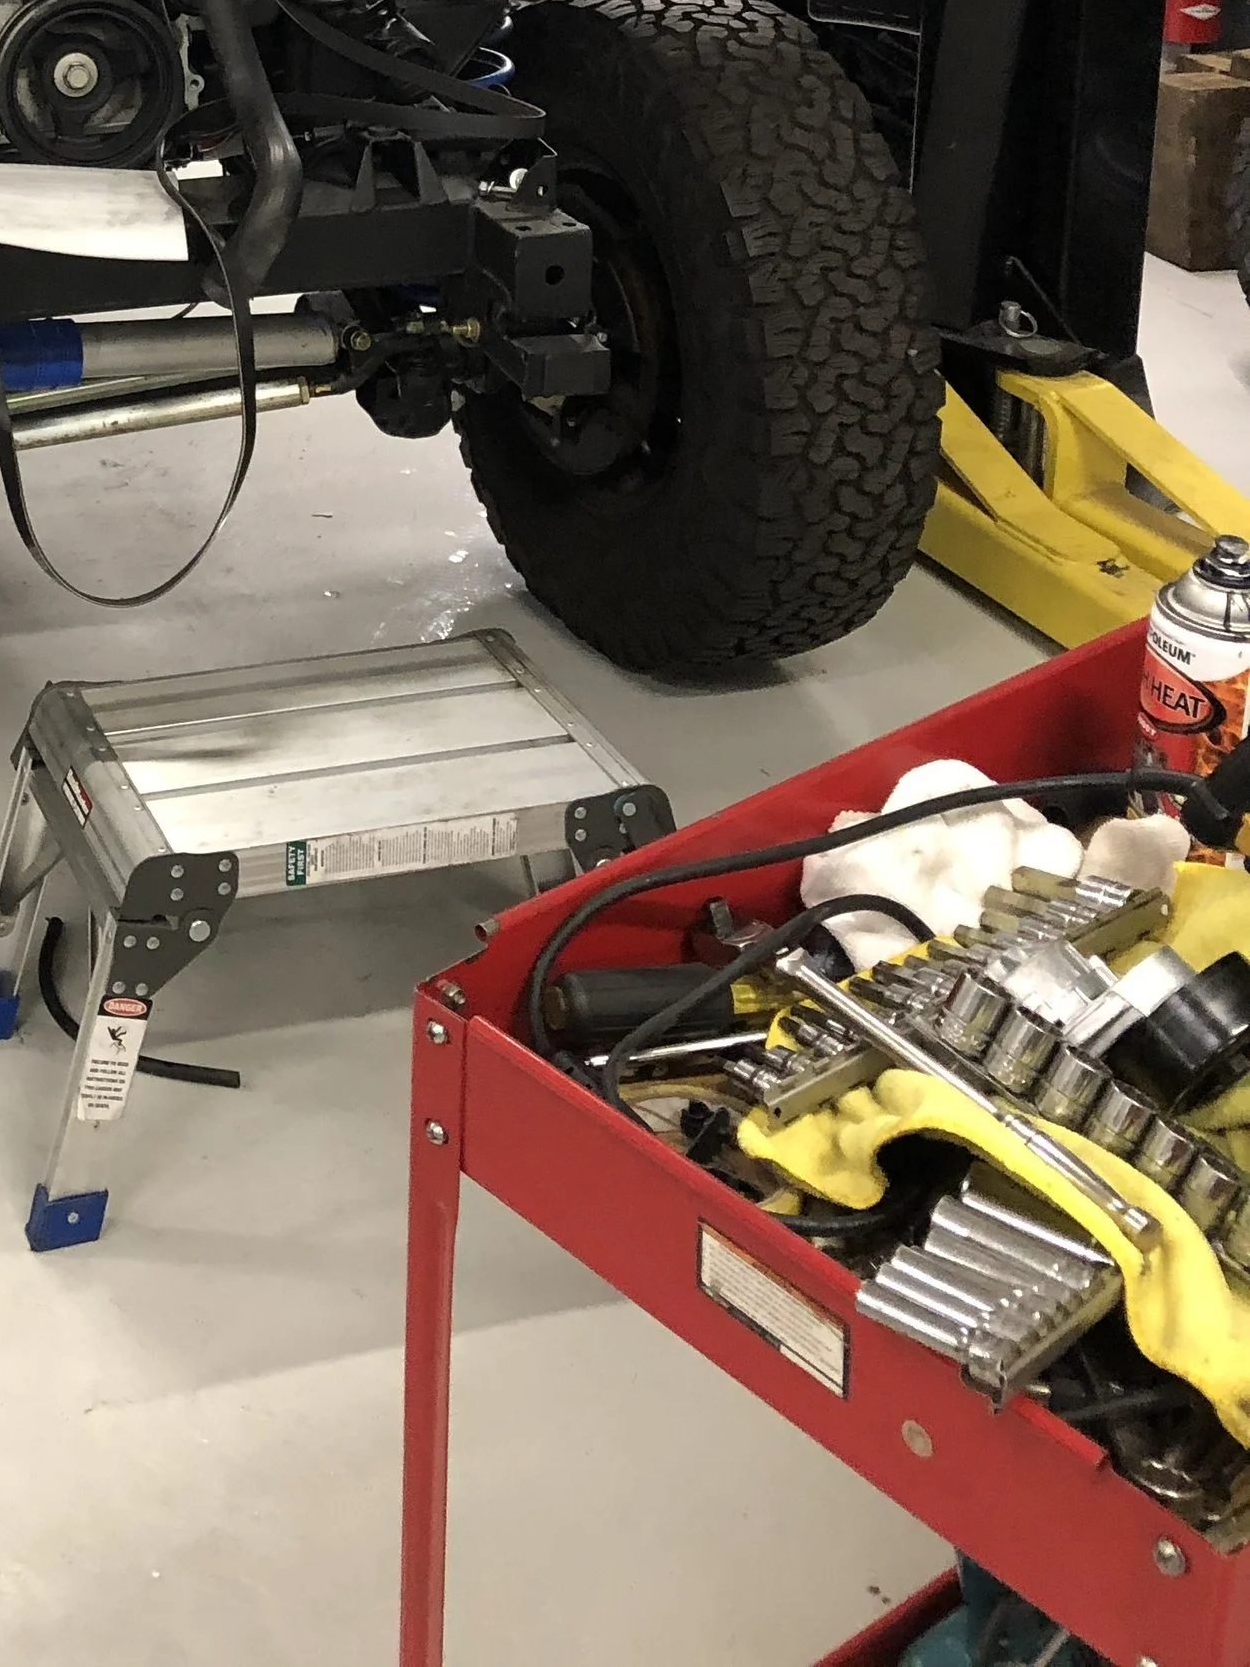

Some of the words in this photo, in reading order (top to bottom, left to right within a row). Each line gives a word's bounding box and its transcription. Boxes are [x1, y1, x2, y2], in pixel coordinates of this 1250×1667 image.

[1151, 676, 1207, 719] HEAT
[287, 845, 296, 881] SAFETY
[296, 848, 305, 876] FIRST
[109, 1001, 143, 1013] DANGER
